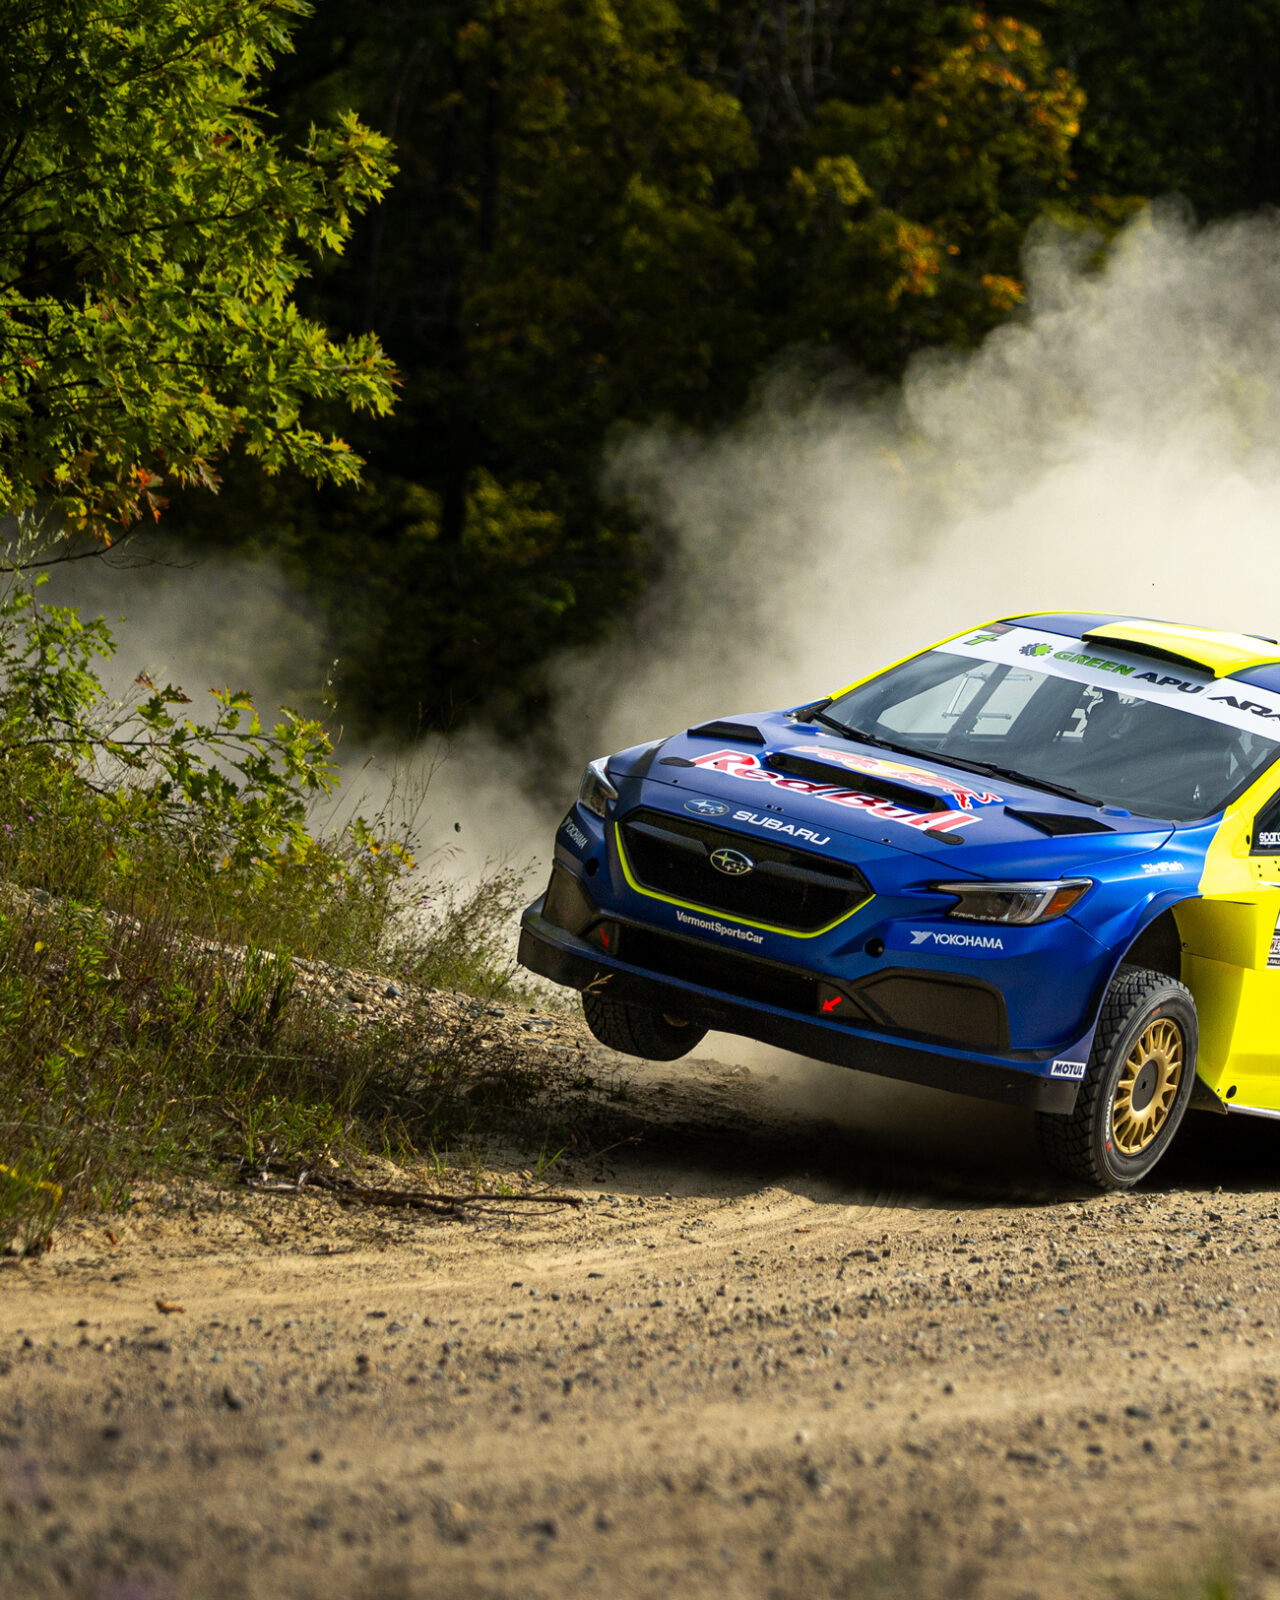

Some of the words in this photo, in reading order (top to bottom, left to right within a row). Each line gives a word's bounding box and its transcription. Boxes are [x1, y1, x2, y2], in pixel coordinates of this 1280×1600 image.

[1053, 651, 1136, 676] GREEN
[1133, 672, 1205, 694] APU
[690, 749, 837, 797] Red
[815, 786, 982, 833] Bull
[732, 810, 831, 846] SUBARU
[676, 910, 764, 944] VermontSportsCar
[933, 933, 1004, 950] YOKOHAMA
[1053, 1063, 1083, 1076] MOTUL
